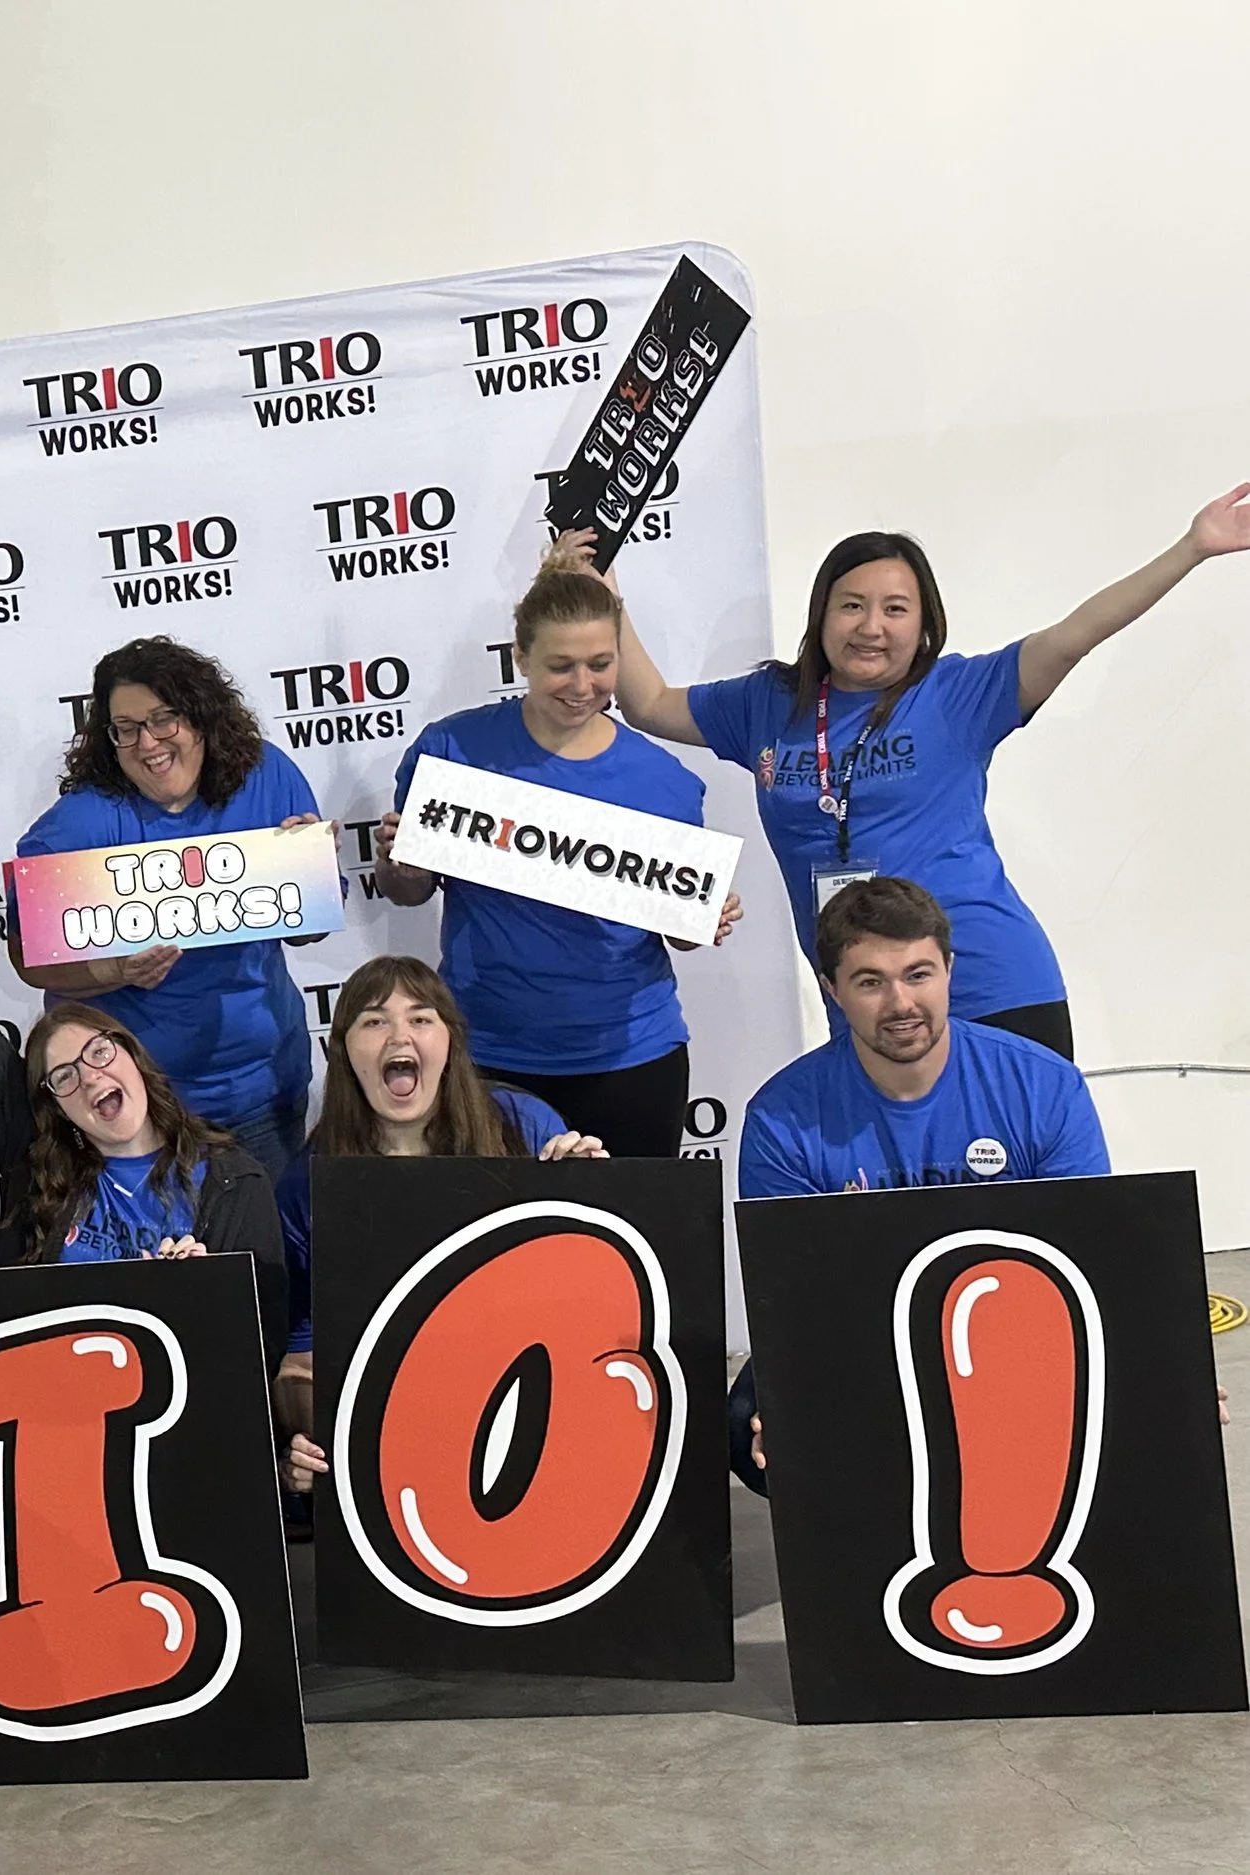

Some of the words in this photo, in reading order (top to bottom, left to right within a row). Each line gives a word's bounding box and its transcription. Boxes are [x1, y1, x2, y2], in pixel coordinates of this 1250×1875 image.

[460, 299, 607, 357] TRIO
[239, 332, 381, 389] TRIO
[475, 352, 600, 396] WORKS!
[23, 363, 162, 418] TRIO
[254, 385, 375, 428] WORKS!
[39, 416, 157, 456] WORKS!
[313, 487, 455, 543] TRIO
[98, 517, 237, 570] TRIO
[328, 540, 450, 581] WORKS!
[114, 569, 231, 608] WORKS!
[270, 657, 409, 710] TRIO
[286, 710, 404, 748] WORKS!
[105, 842, 245, 896] TRIO
[419, 799, 715, 904] #TRIOWORKS!
[62, 882, 303, 949] WORKS!
[334, 1201, 687, 1626] O
[883, 1229, 1105, 1675] !
